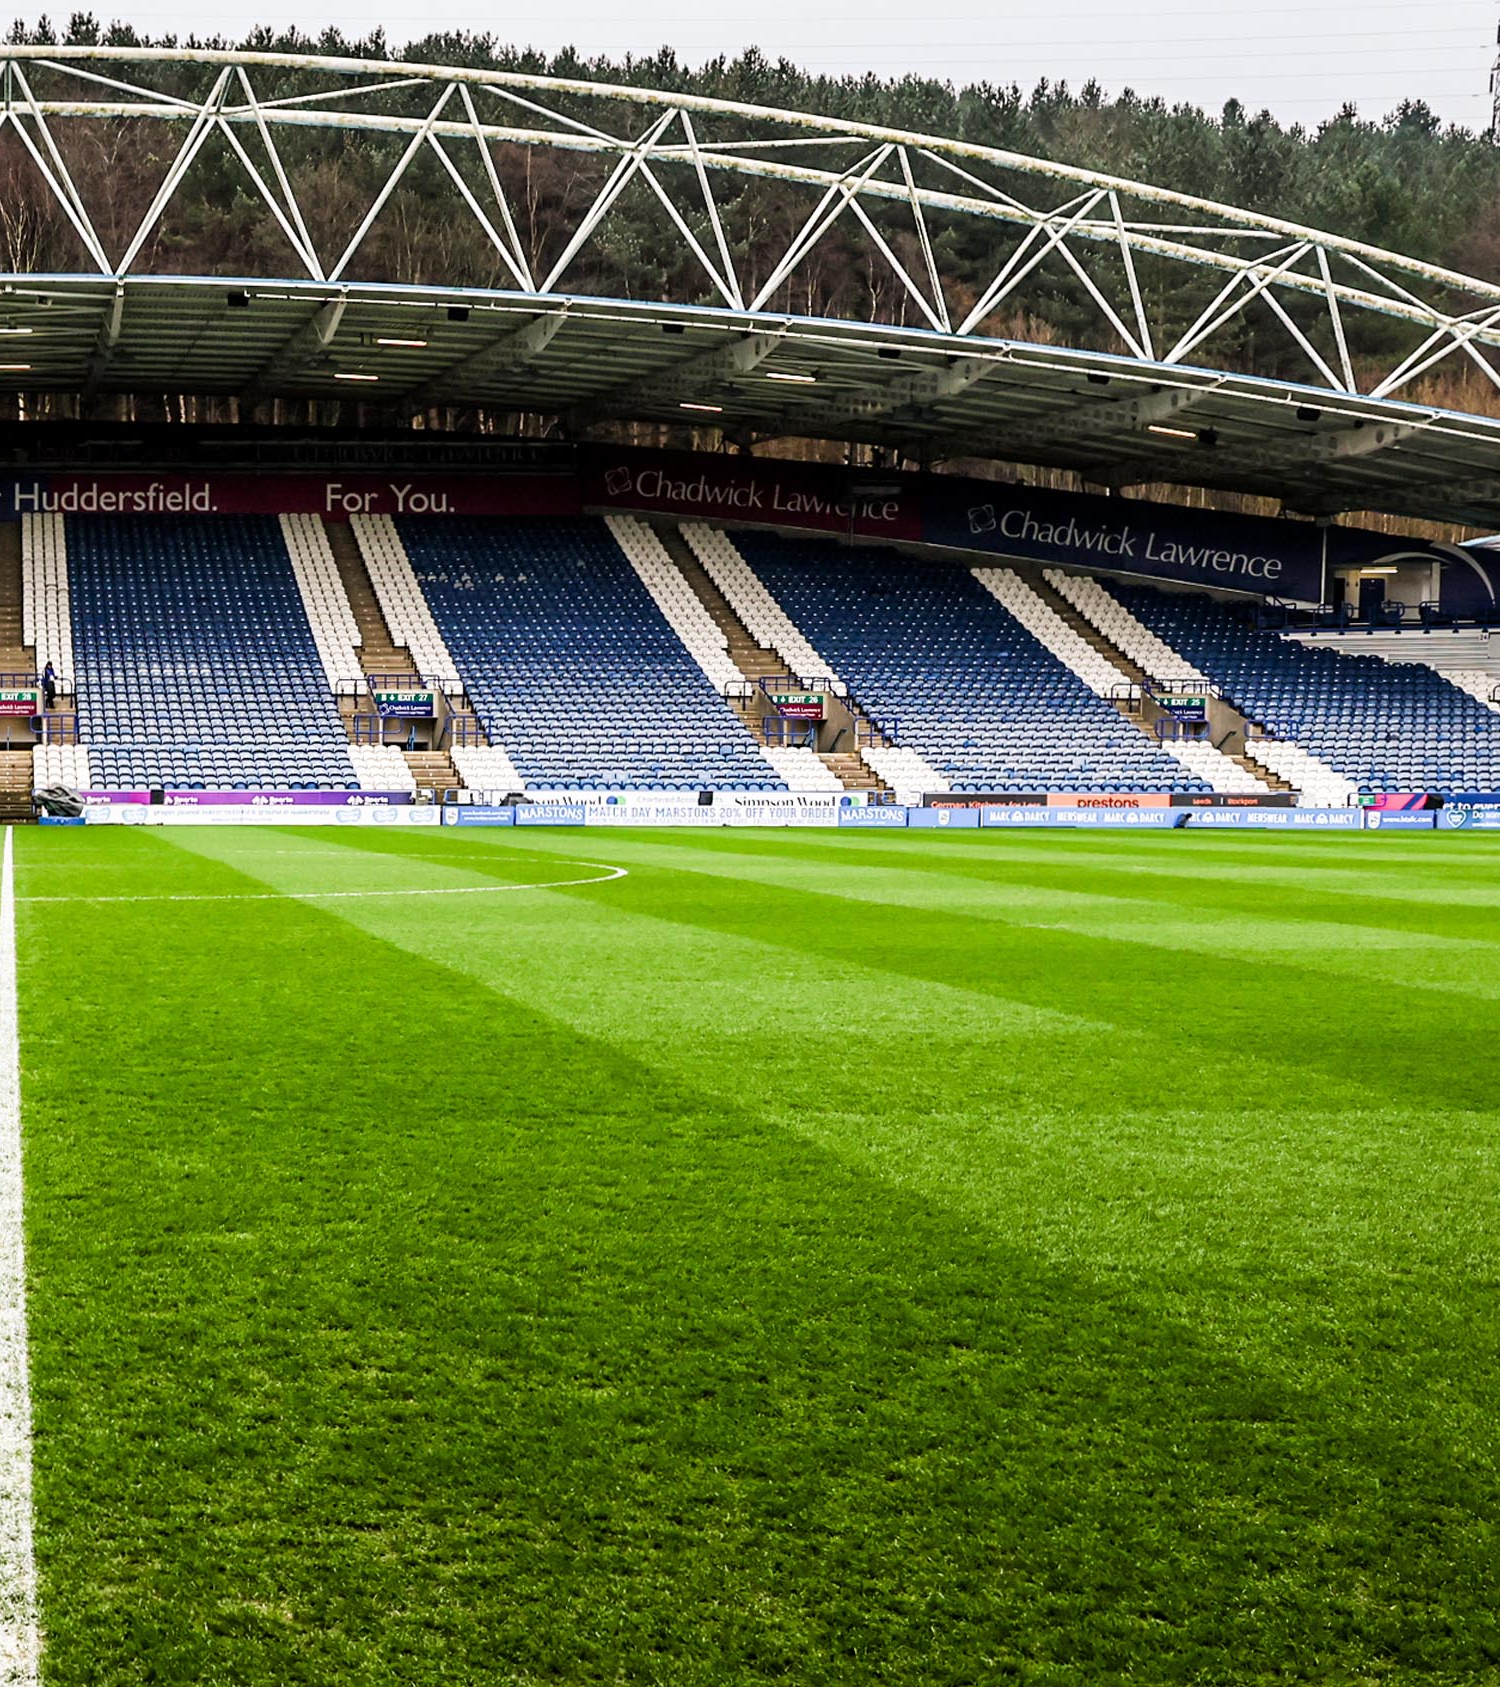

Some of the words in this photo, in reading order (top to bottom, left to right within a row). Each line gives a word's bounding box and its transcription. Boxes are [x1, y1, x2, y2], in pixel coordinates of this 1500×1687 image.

[636, 469, 763, 509] Chadwick
[14, 482, 218, 512] Huddersfield.
[325, 483, 378, 512] For
[389, 484, 455, 512] You.
[1001, 510, 1137, 557] Chadwick
[1145, 533, 1282, 580] Lawrence
[1171, 698, 1188, 706] EXIT
[1077, 797, 1140, 808] prestons
[1228, 798, 1259, 806] Stockport
[519, 806, 584, 820] MARSTONS
[589, 807, 627, 817] MATCH
[631, 807, 651, 817] DAY
[655, 807, 716, 818] MARSTONS
[719, 808, 742, 818] 20%
[745, 808, 762, 818] OFF
[769, 808, 797, 818] YOUR
[801, 808, 836, 818] ORDER
[841, 808, 905, 822] MARSTONS
[1025, 811, 1050, 822] DARCY
[1140, 812, 1165, 823] DARCY
[1216, 812, 1241, 823] DARCY
[1329, 813, 1354, 825] DARCY
